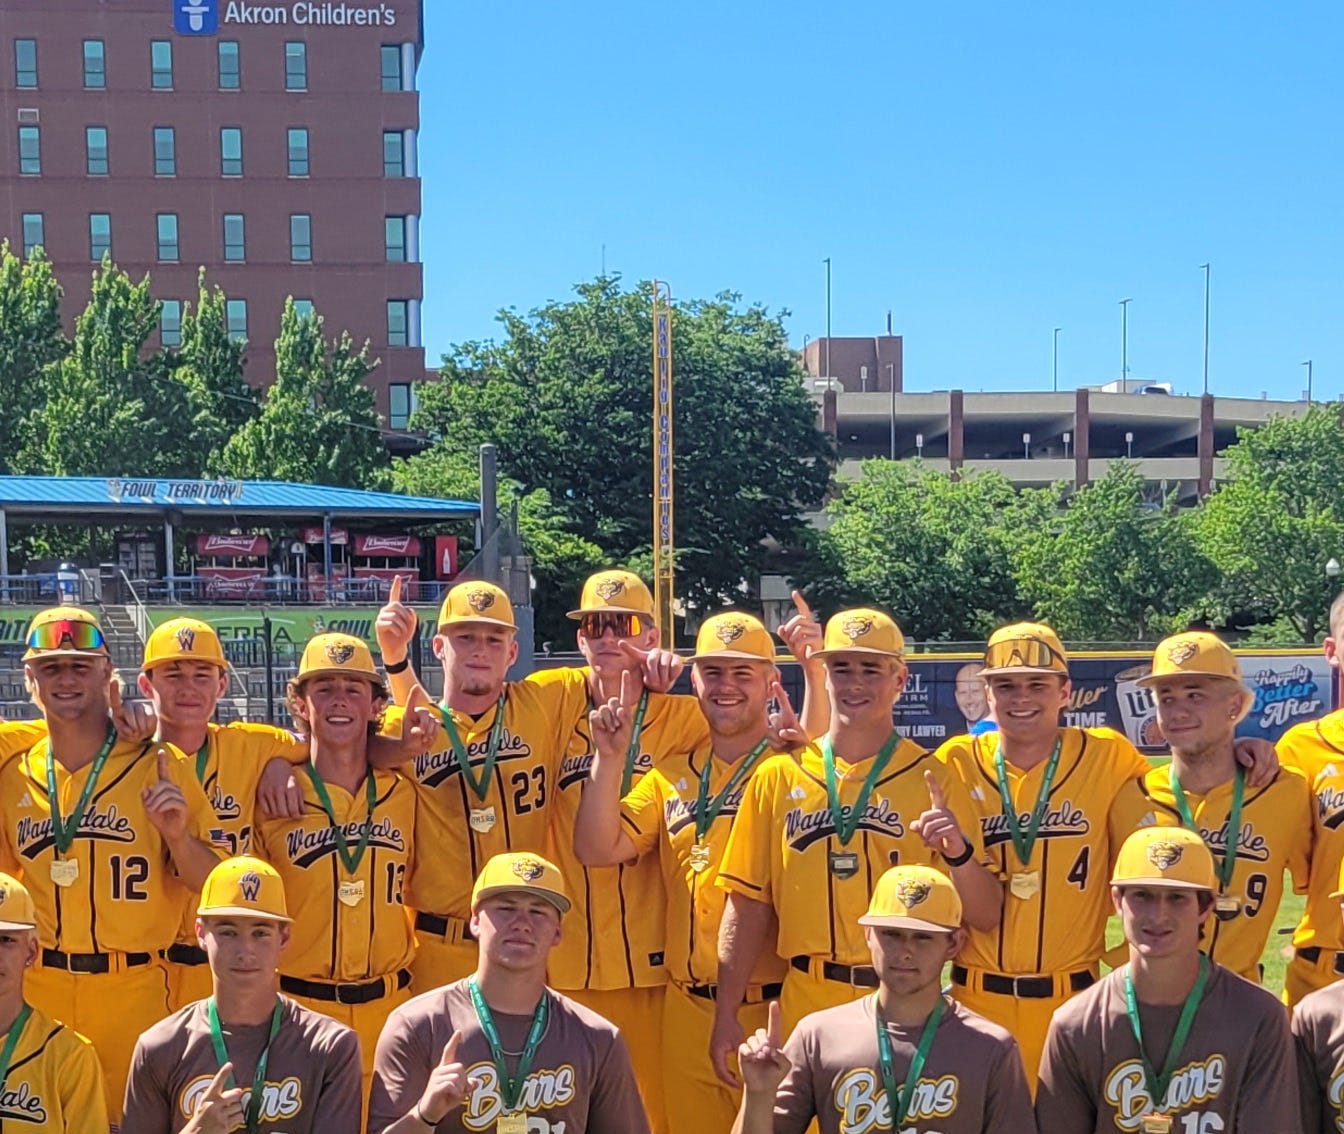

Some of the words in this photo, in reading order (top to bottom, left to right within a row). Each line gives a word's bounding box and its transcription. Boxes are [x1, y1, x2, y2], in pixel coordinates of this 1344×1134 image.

[224, 2, 287, 24] Akron
[292, 2, 396, 26] Children's
[166, 483, 236, 500] TERRITORY
[217, 626, 292, 642] ERA
[1256, 665, 1309, 687] Happily
[1065, 685, 1109, 711] ller
[1127, 686, 1156, 718] Lit
[1259, 699, 1321, 728] After
[912, 725, 946, 737] LAWYER
[1063, 711, 1107, 728] TIME
[412, 729, 530, 779] Wayedle
[511, 765, 547, 816] 23
[16, 804, 136, 849] Waydale
[785, 799, 903, 841] Wayneale
[980, 800, 1090, 836] ayneale
[286, 818, 404, 860] Wayeale
[109, 854, 149, 901] 12
[1067, 845, 1090, 891] 4
[1244, 872, 1269, 919] 9
[462, 1060, 576, 1132] Bars
[1105, 1053, 1227, 1133] Bars
